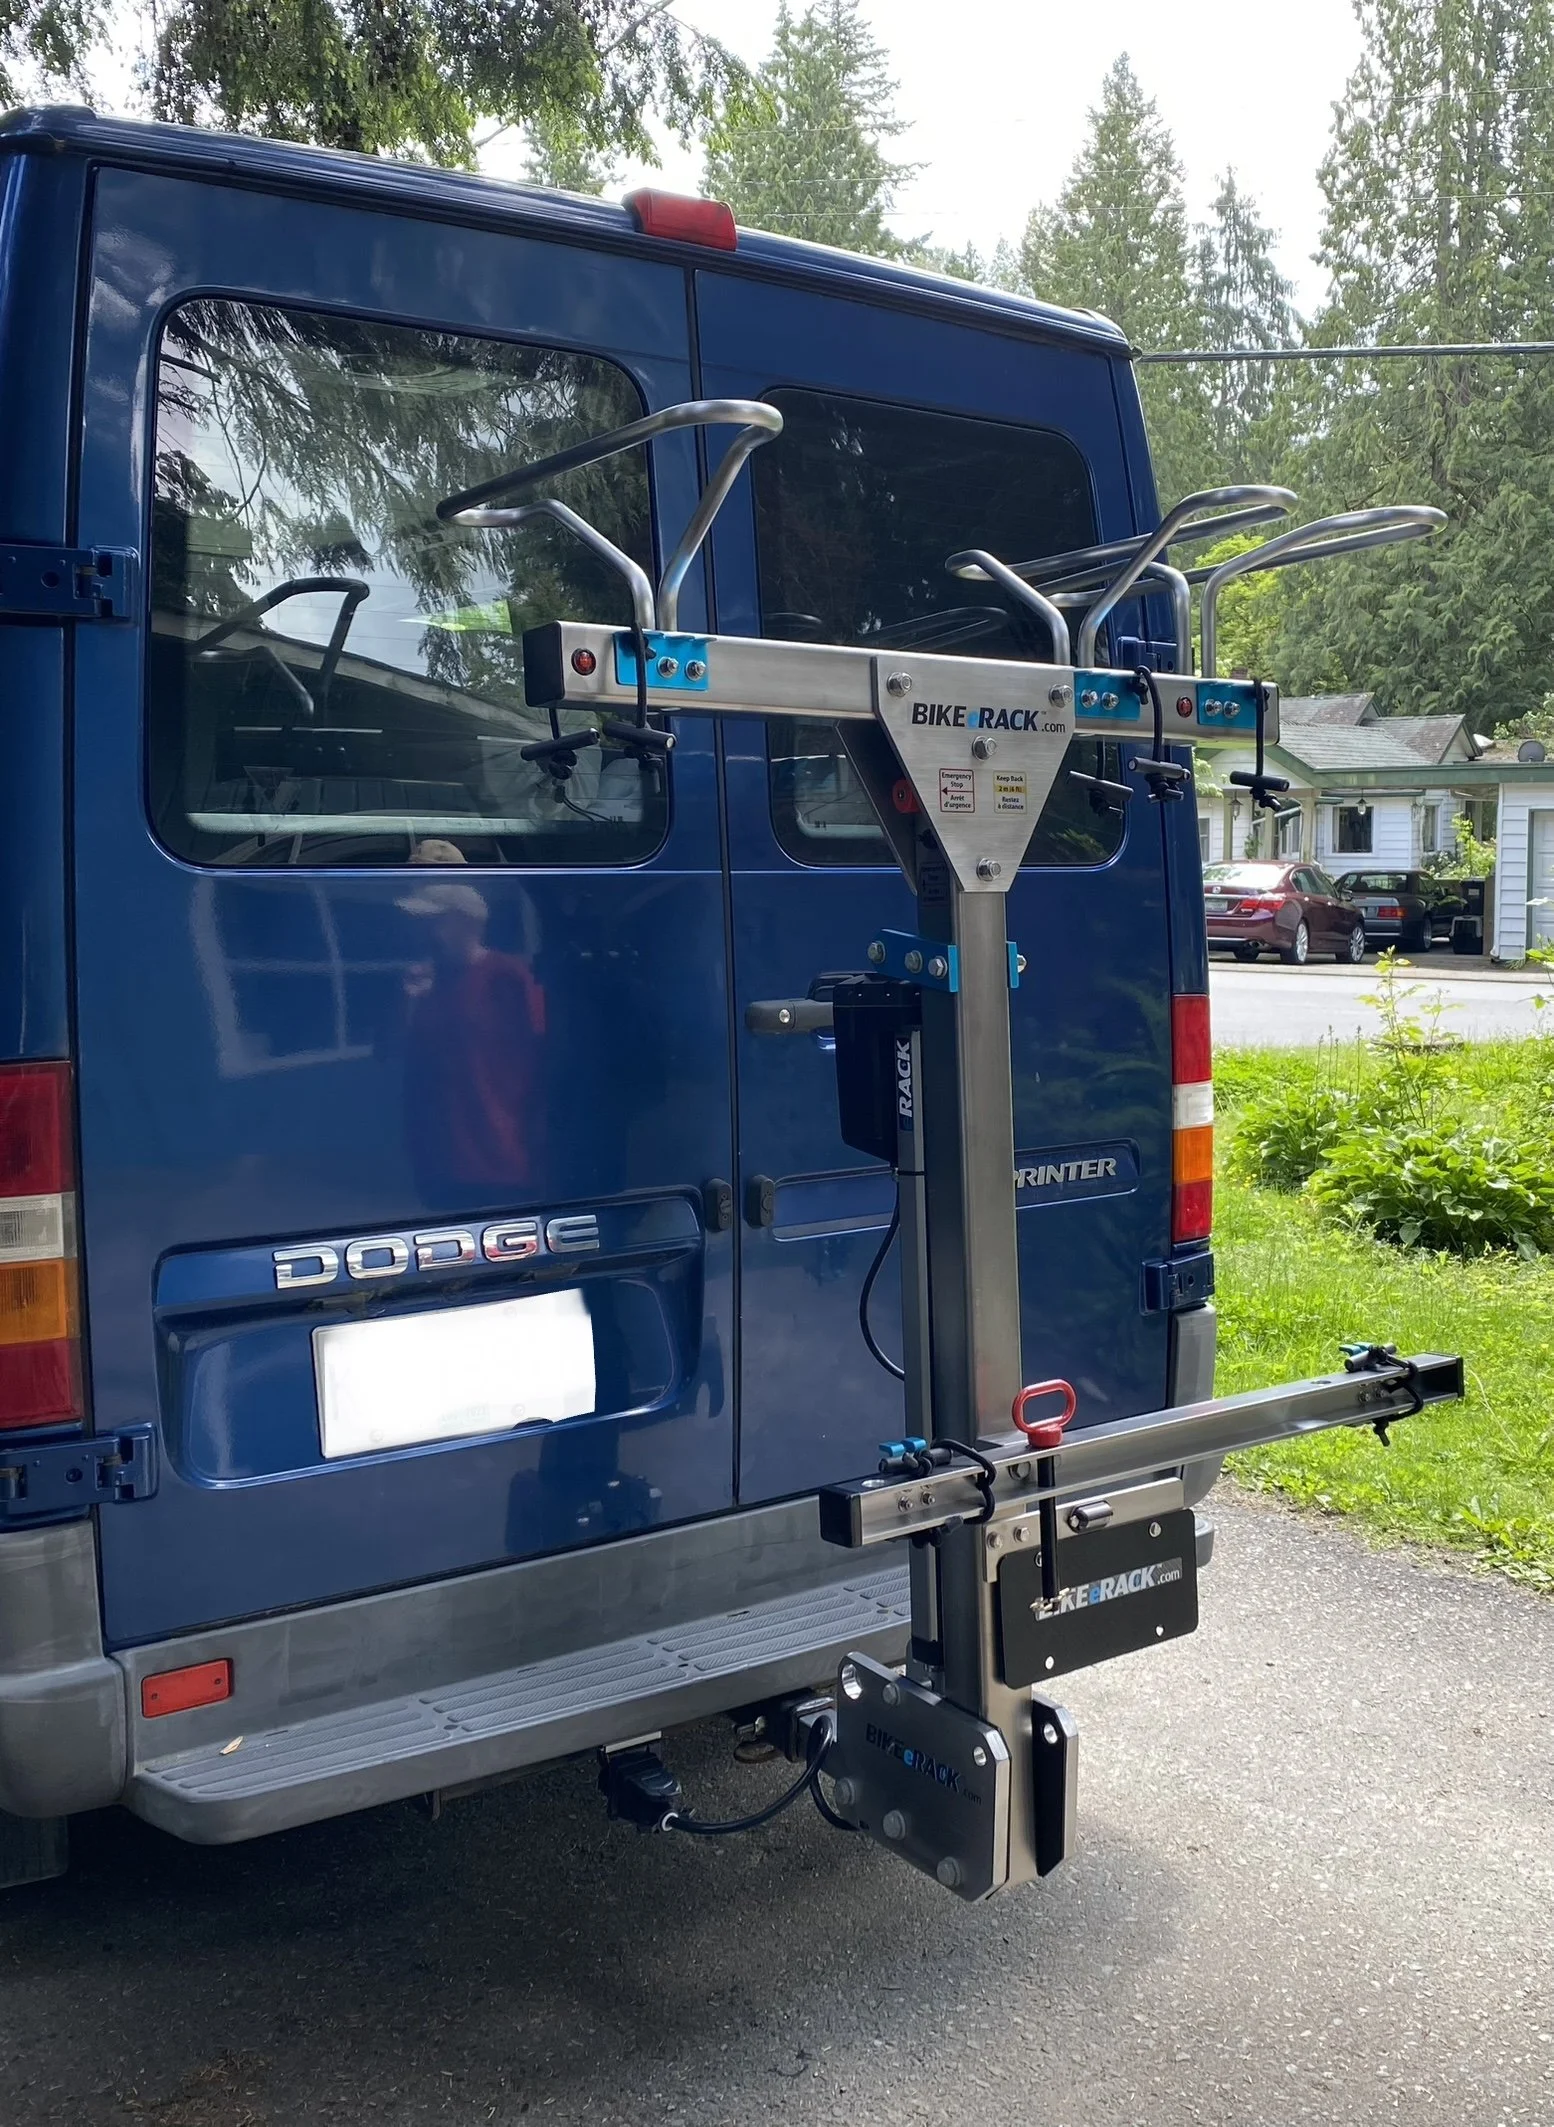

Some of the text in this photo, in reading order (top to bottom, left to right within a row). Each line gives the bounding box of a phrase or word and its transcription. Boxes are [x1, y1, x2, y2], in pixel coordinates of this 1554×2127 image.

[941, 772, 972, 781] Emergency
[996, 775, 1024, 783] Keep Back
[950, 780, 964, 789] Stop
[273, 1214, 600, 1290] DODGE
